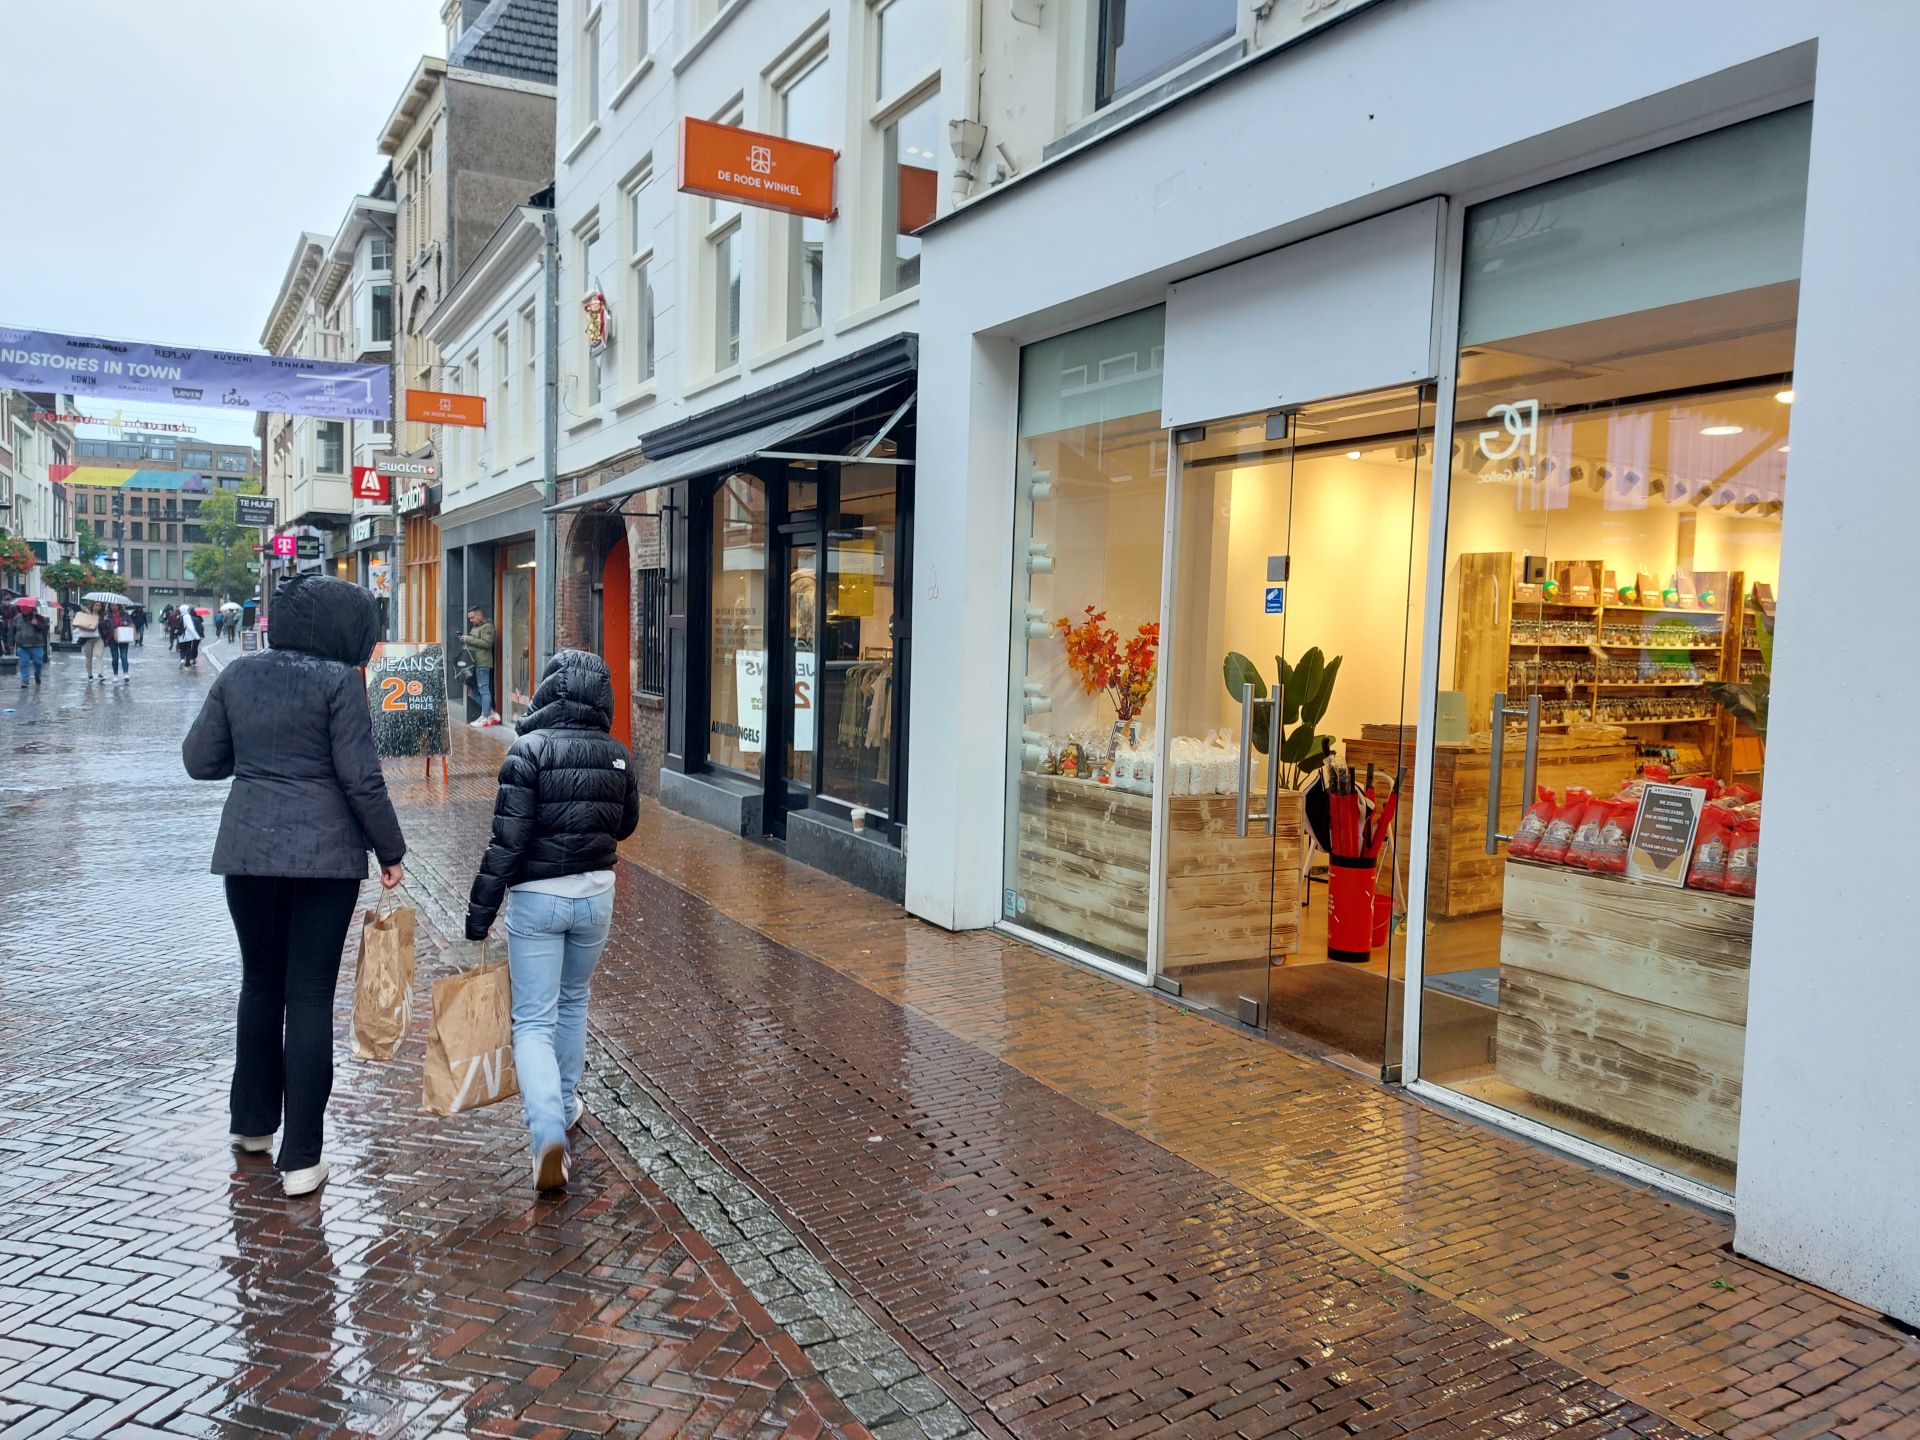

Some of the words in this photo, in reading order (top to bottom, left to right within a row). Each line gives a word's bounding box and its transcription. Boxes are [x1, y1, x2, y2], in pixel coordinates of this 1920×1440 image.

[718, 170, 731, 182] DE
[733, 173, 761, 188] RODE
[764, 179, 802, 196] WINKEL
[66, 340, 128, 353] ARMEDANGELS
[154, 348, 192, 361] REPLAY
[213, 353, 253, 363] KUYICHI
[103, 360, 123, 375] IN
[127, 363, 181, 381] TOWN
[271, 360, 315, 370] DENHAM
[71, 375, 97, 385] EDWIN
[221, 394, 250, 407] Lois
[378, 461, 426, 474] swatch
[240, 499, 250, 507] TE
[277, 538, 292, 553] T
[373, 656, 435, 672] JEANS
[711, 720, 760, 744] ARMEDANGELS
